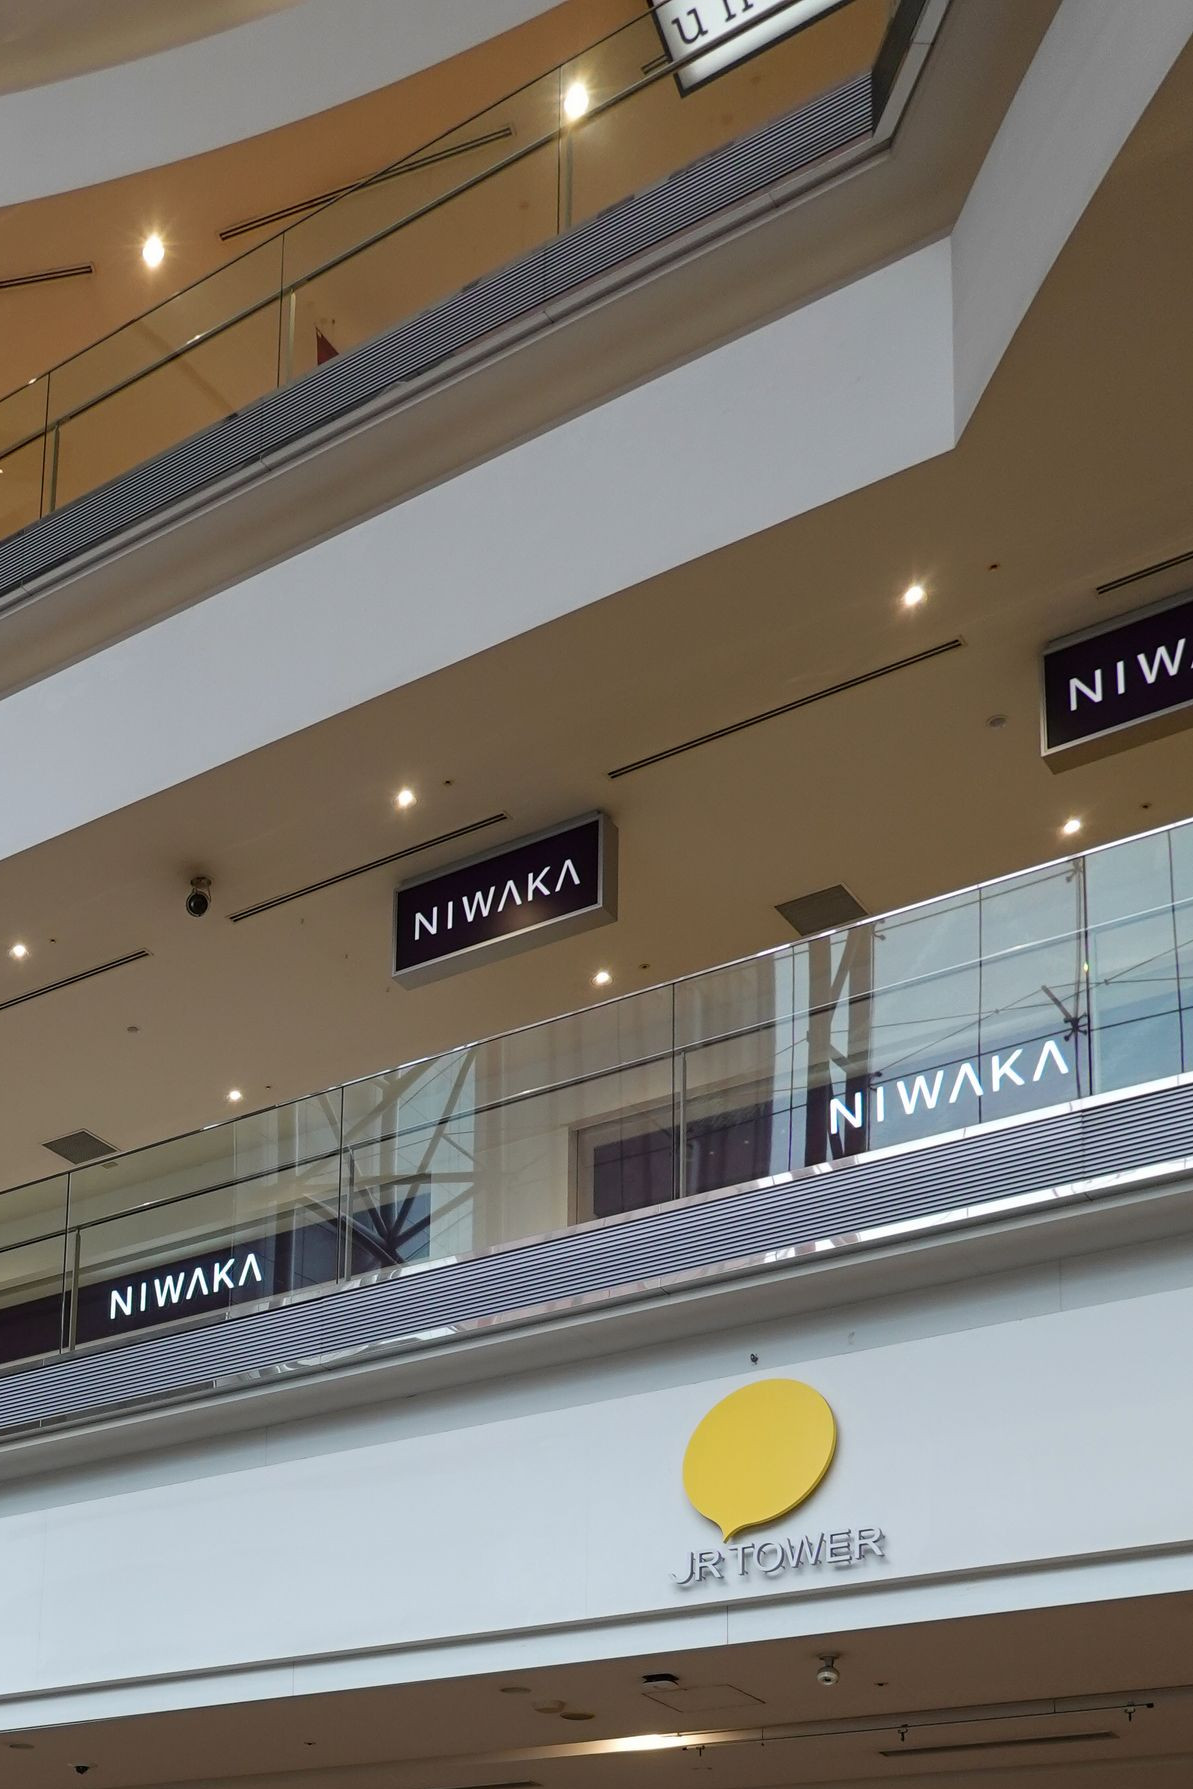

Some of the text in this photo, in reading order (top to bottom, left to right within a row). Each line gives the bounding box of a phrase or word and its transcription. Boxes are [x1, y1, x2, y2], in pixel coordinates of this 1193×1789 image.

[1069, 637, 1193, 712] NIW
[414, 858, 581, 941] NIWAKA
[829, 1040, 1070, 1135] NIWAKA
[109, 1252, 263, 1320] NIWAKA
[671, 1527, 886, 1585] JR TOWER
